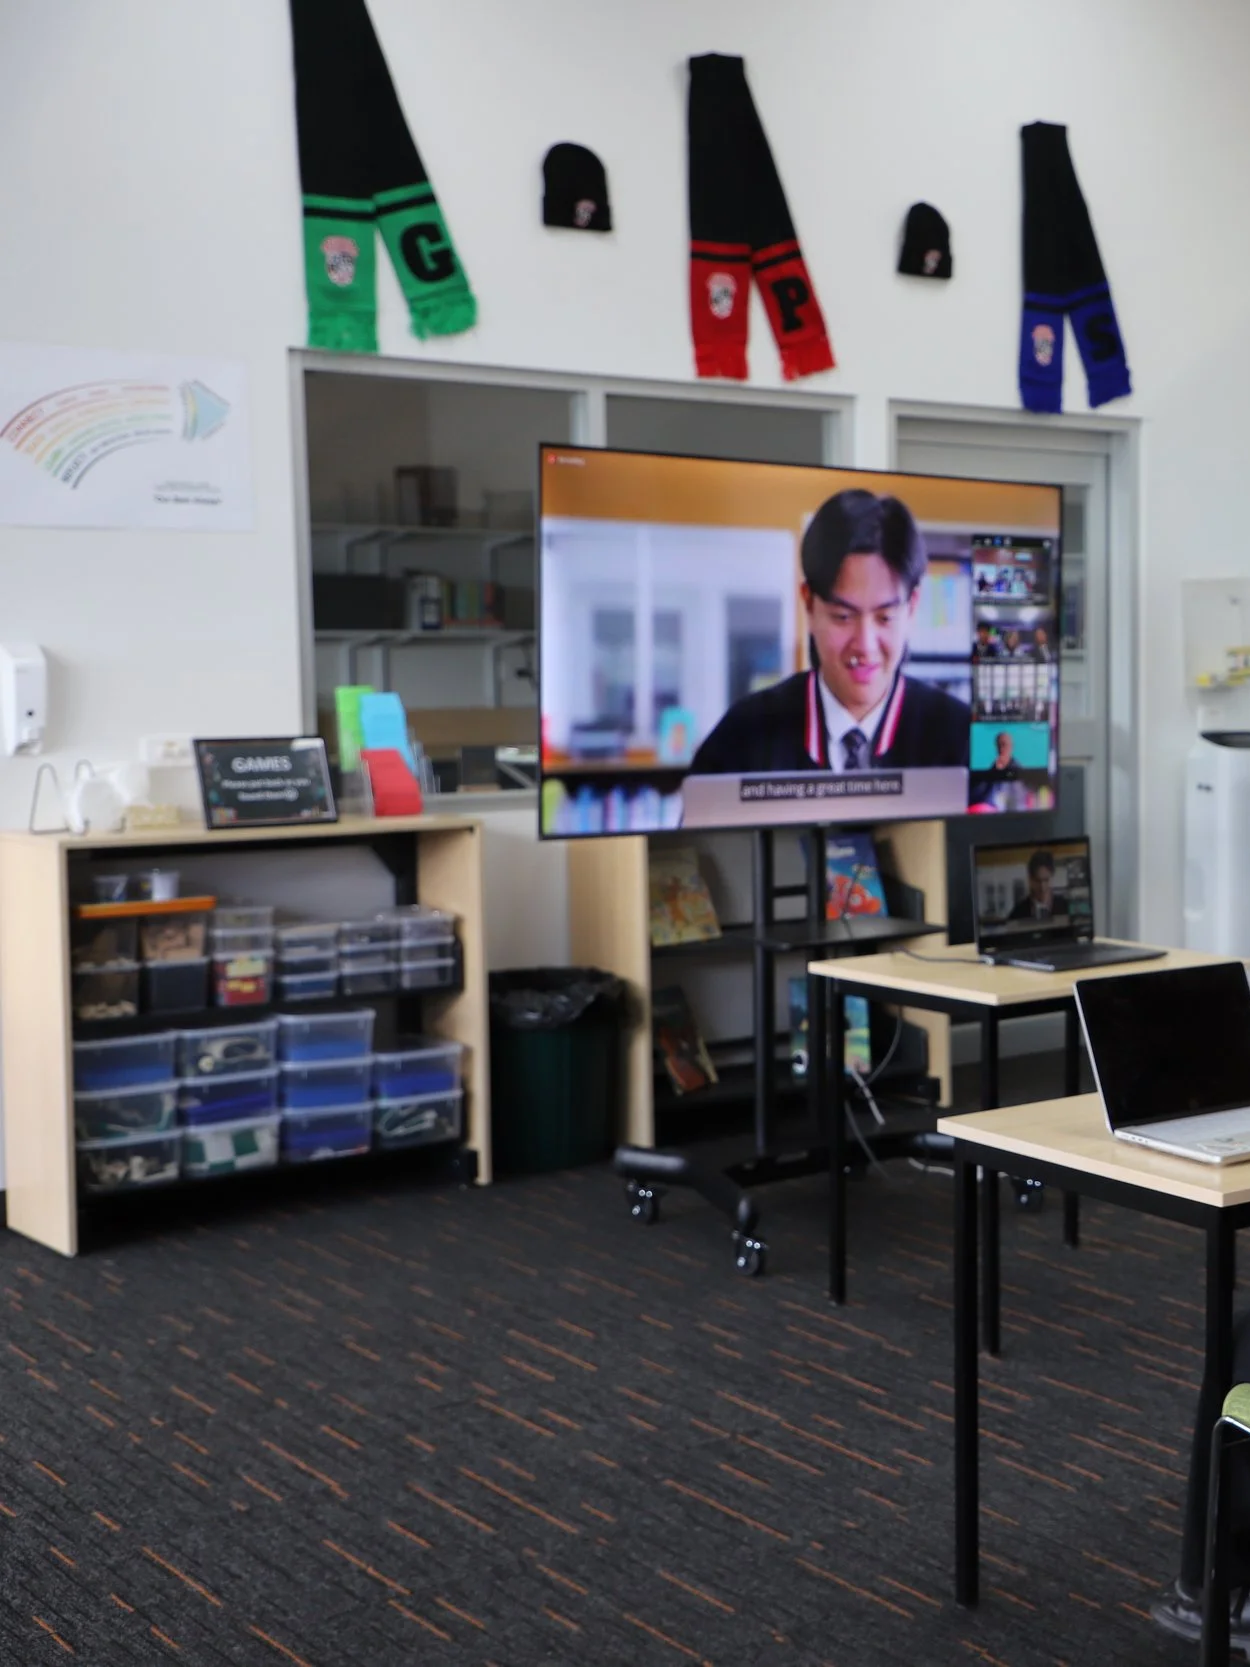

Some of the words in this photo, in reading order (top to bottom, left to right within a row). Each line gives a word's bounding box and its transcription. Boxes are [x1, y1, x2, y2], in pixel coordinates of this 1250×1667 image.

[400, 222, 456, 283] G
[771, 276, 810, 332] P
[1085, 314, 1118, 362] S
[231, 755, 293, 773] GAMES
[743, 783, 766, 797] and
[767, 782, 805, 798] having
[806, 783, 814, 795] a
[815, 782, 846, 798] great
[847, 780, 872, 794] time
[874, 779, 899, 792] here
